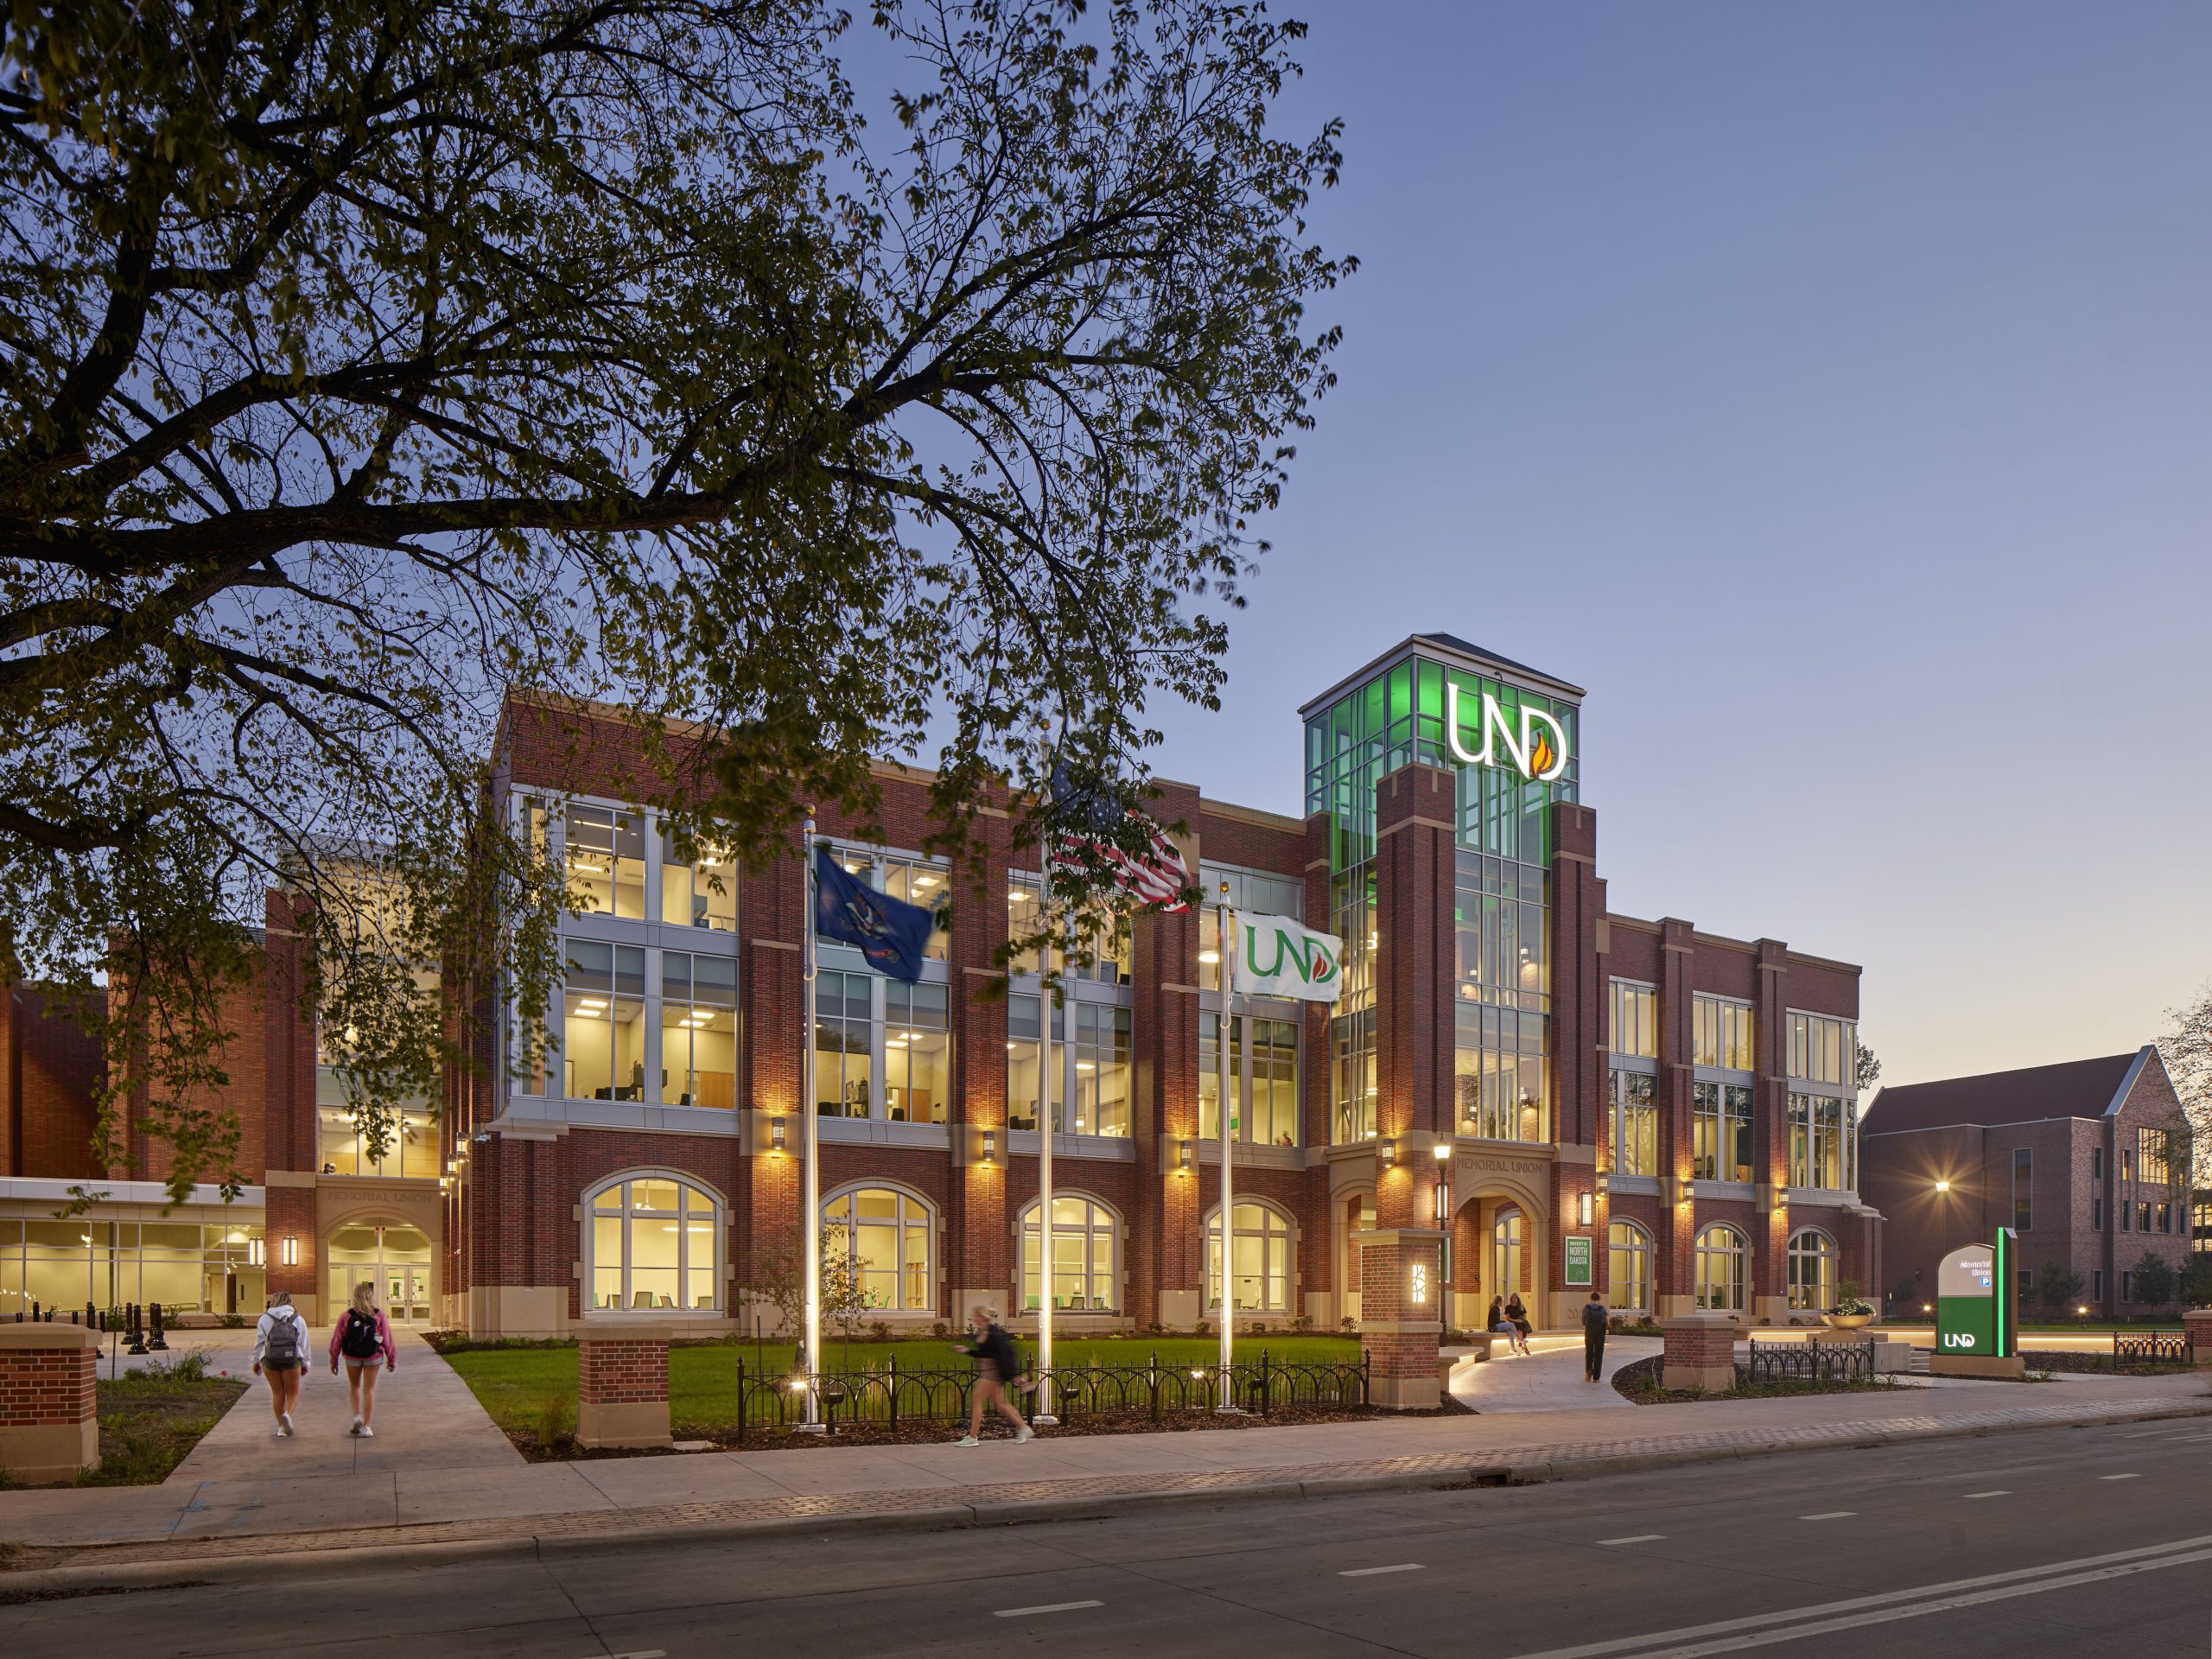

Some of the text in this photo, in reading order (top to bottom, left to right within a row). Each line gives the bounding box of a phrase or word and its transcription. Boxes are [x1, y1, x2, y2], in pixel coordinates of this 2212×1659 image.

[1447, 682, 1567, 781] UND
[1244, 925, 1339, 984] UND
[1456, 1157, 1542, 1174] MEMORIAL UNION
[394, 1192, 432, 1203] UNION
[1569, 1247, 1588, 1256] NORTH
[1960, 1260, 1992, 1268] Memorial
[1944, 1333, 1976, 1348] UND
